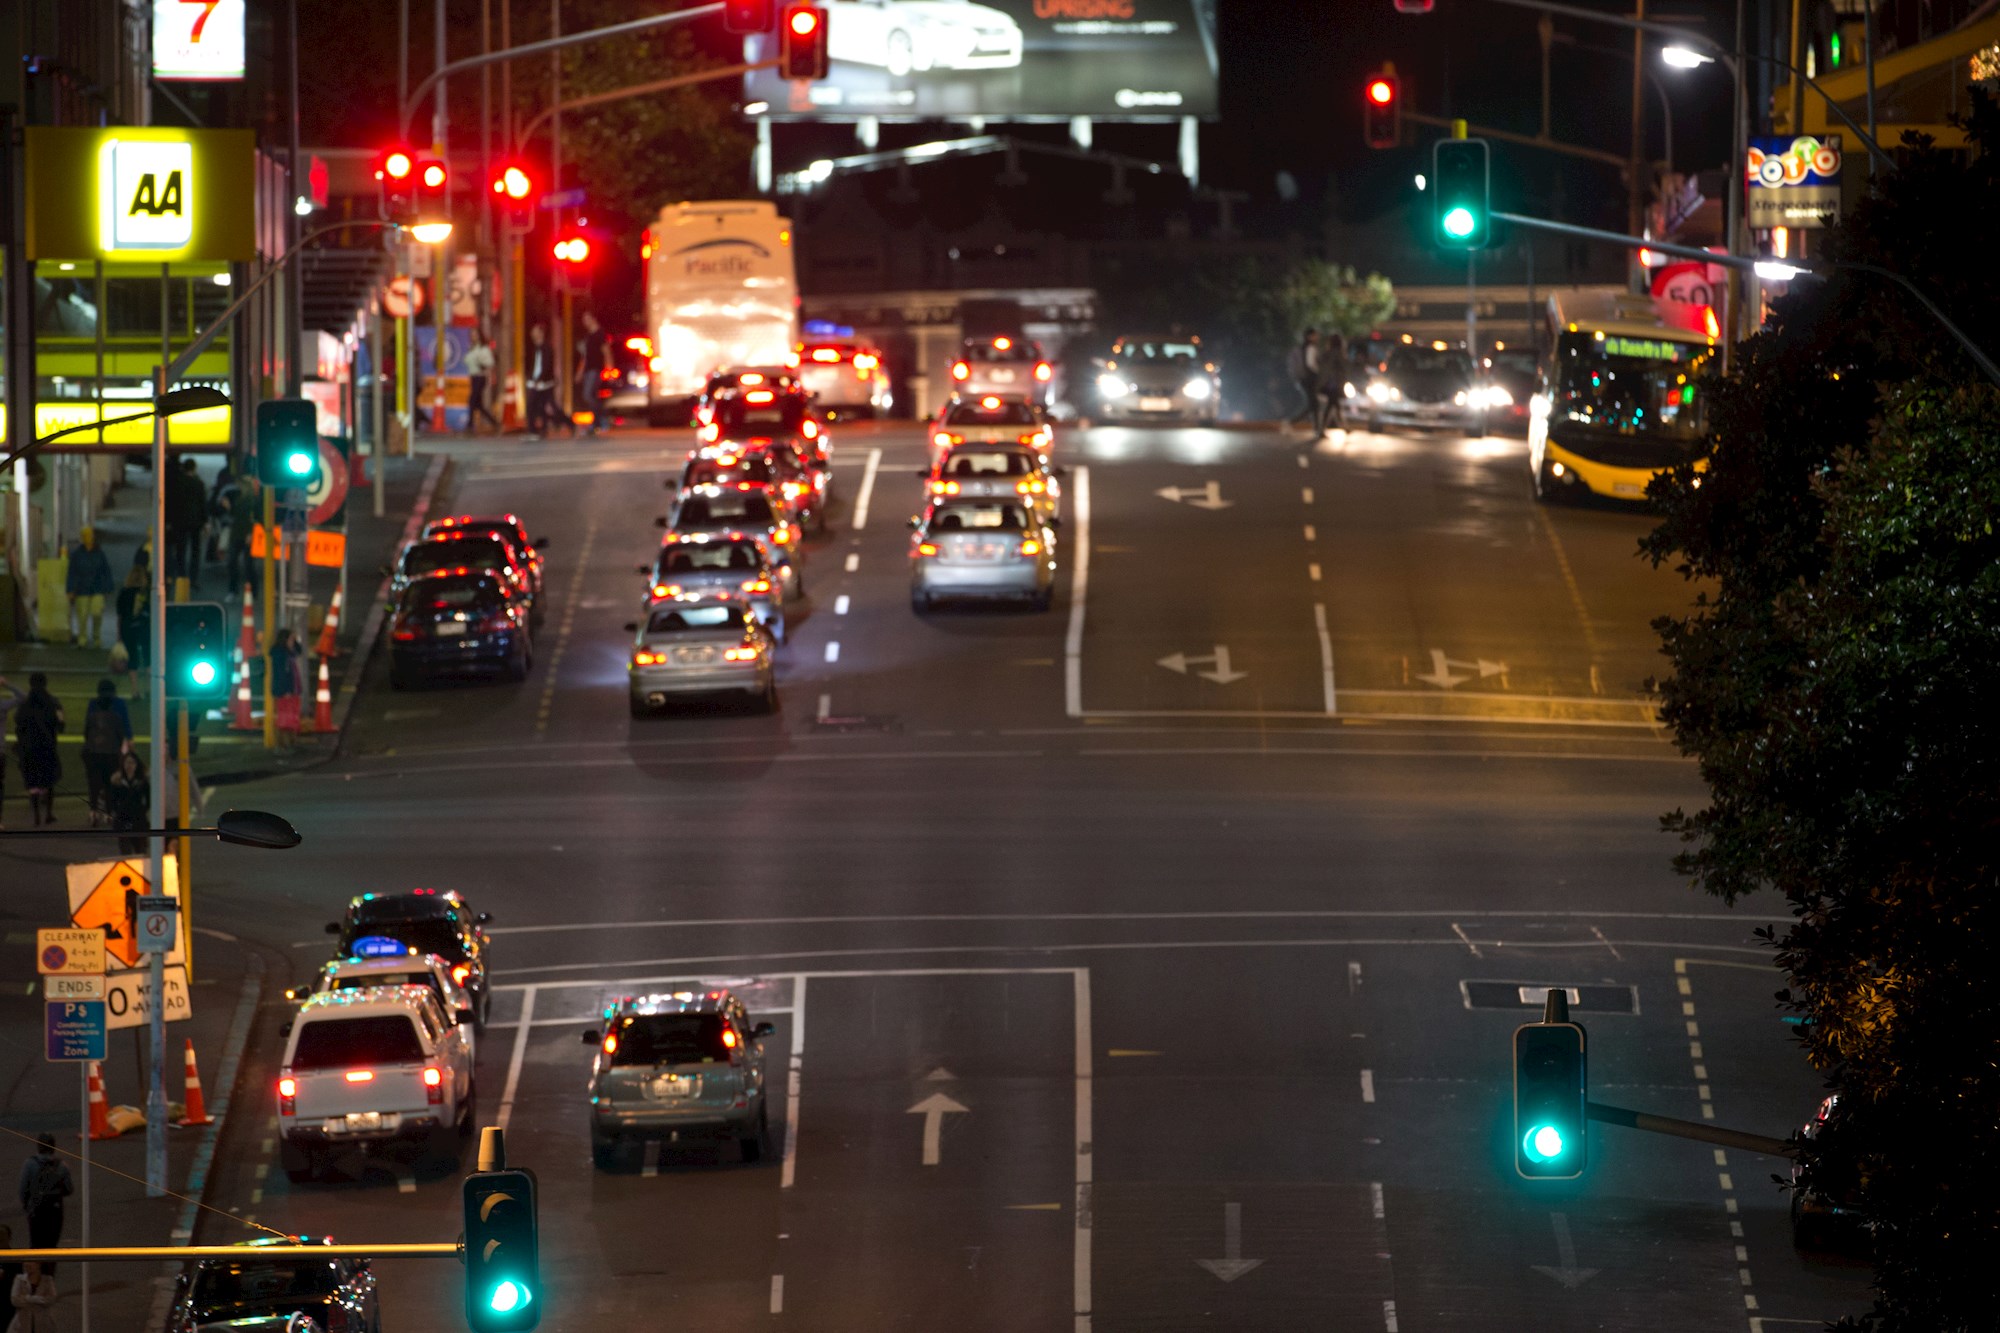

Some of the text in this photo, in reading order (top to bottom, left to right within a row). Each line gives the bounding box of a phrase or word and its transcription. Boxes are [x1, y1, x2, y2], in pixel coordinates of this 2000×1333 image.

[178, 0, 220, 43] 7
[1748, 140, 1838, 184] LOTTO
[128, 170, 182, 216] AA
[44, 932, 98, 942] CLEARWAY
[57, 980, 93, 993] ENDS
[65, 1003, 76, 1018] P
[108, 987, 128, 1016] 0
[132, 996, 186, 1014] AHAD
[63, 1045, 90, 1056] Zone
